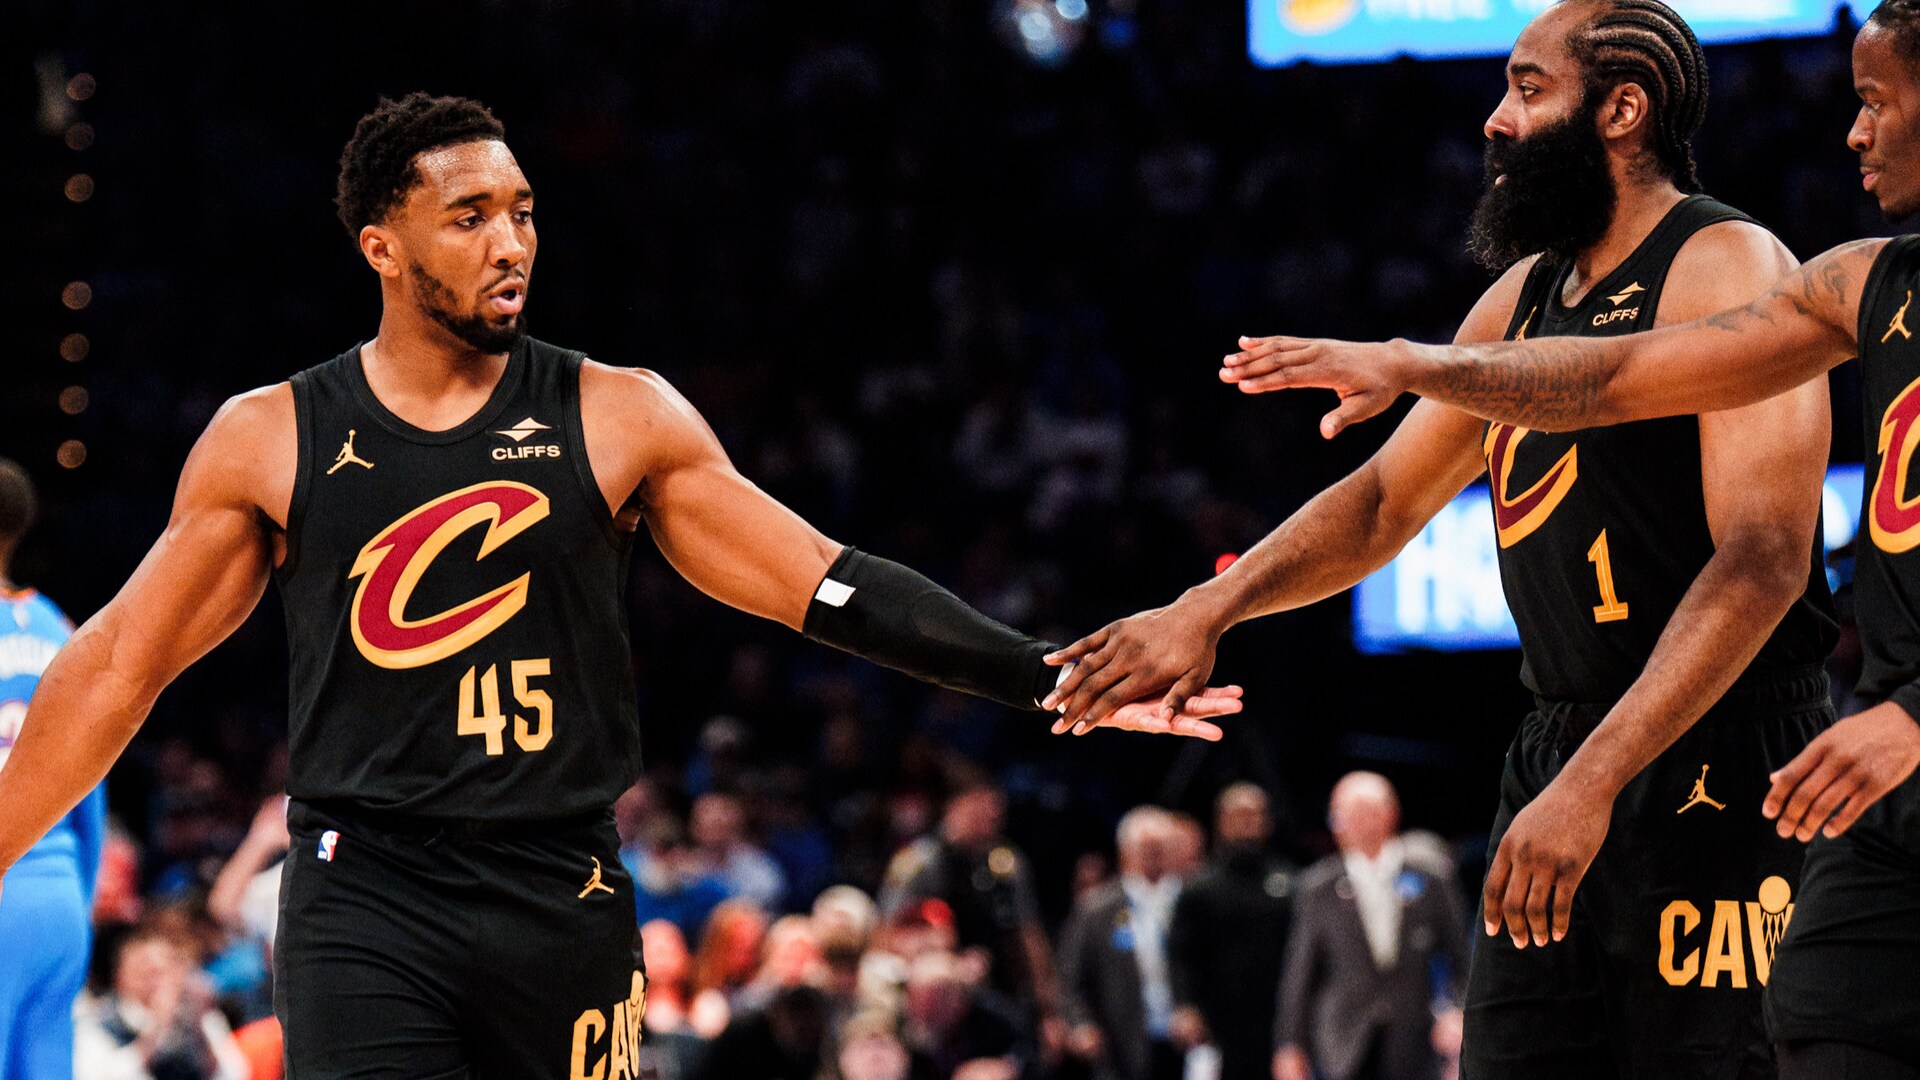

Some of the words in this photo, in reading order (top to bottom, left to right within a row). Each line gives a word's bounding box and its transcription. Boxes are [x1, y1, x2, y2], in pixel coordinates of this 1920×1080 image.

[1592, 307, 1639, 327] CLIFFS
[491, 445, 561, 461] CLIFFS
[348, 480, 550, 670] C
[1587, 528, 1629, 623] 1
[457, 658, 553, 756] 45
